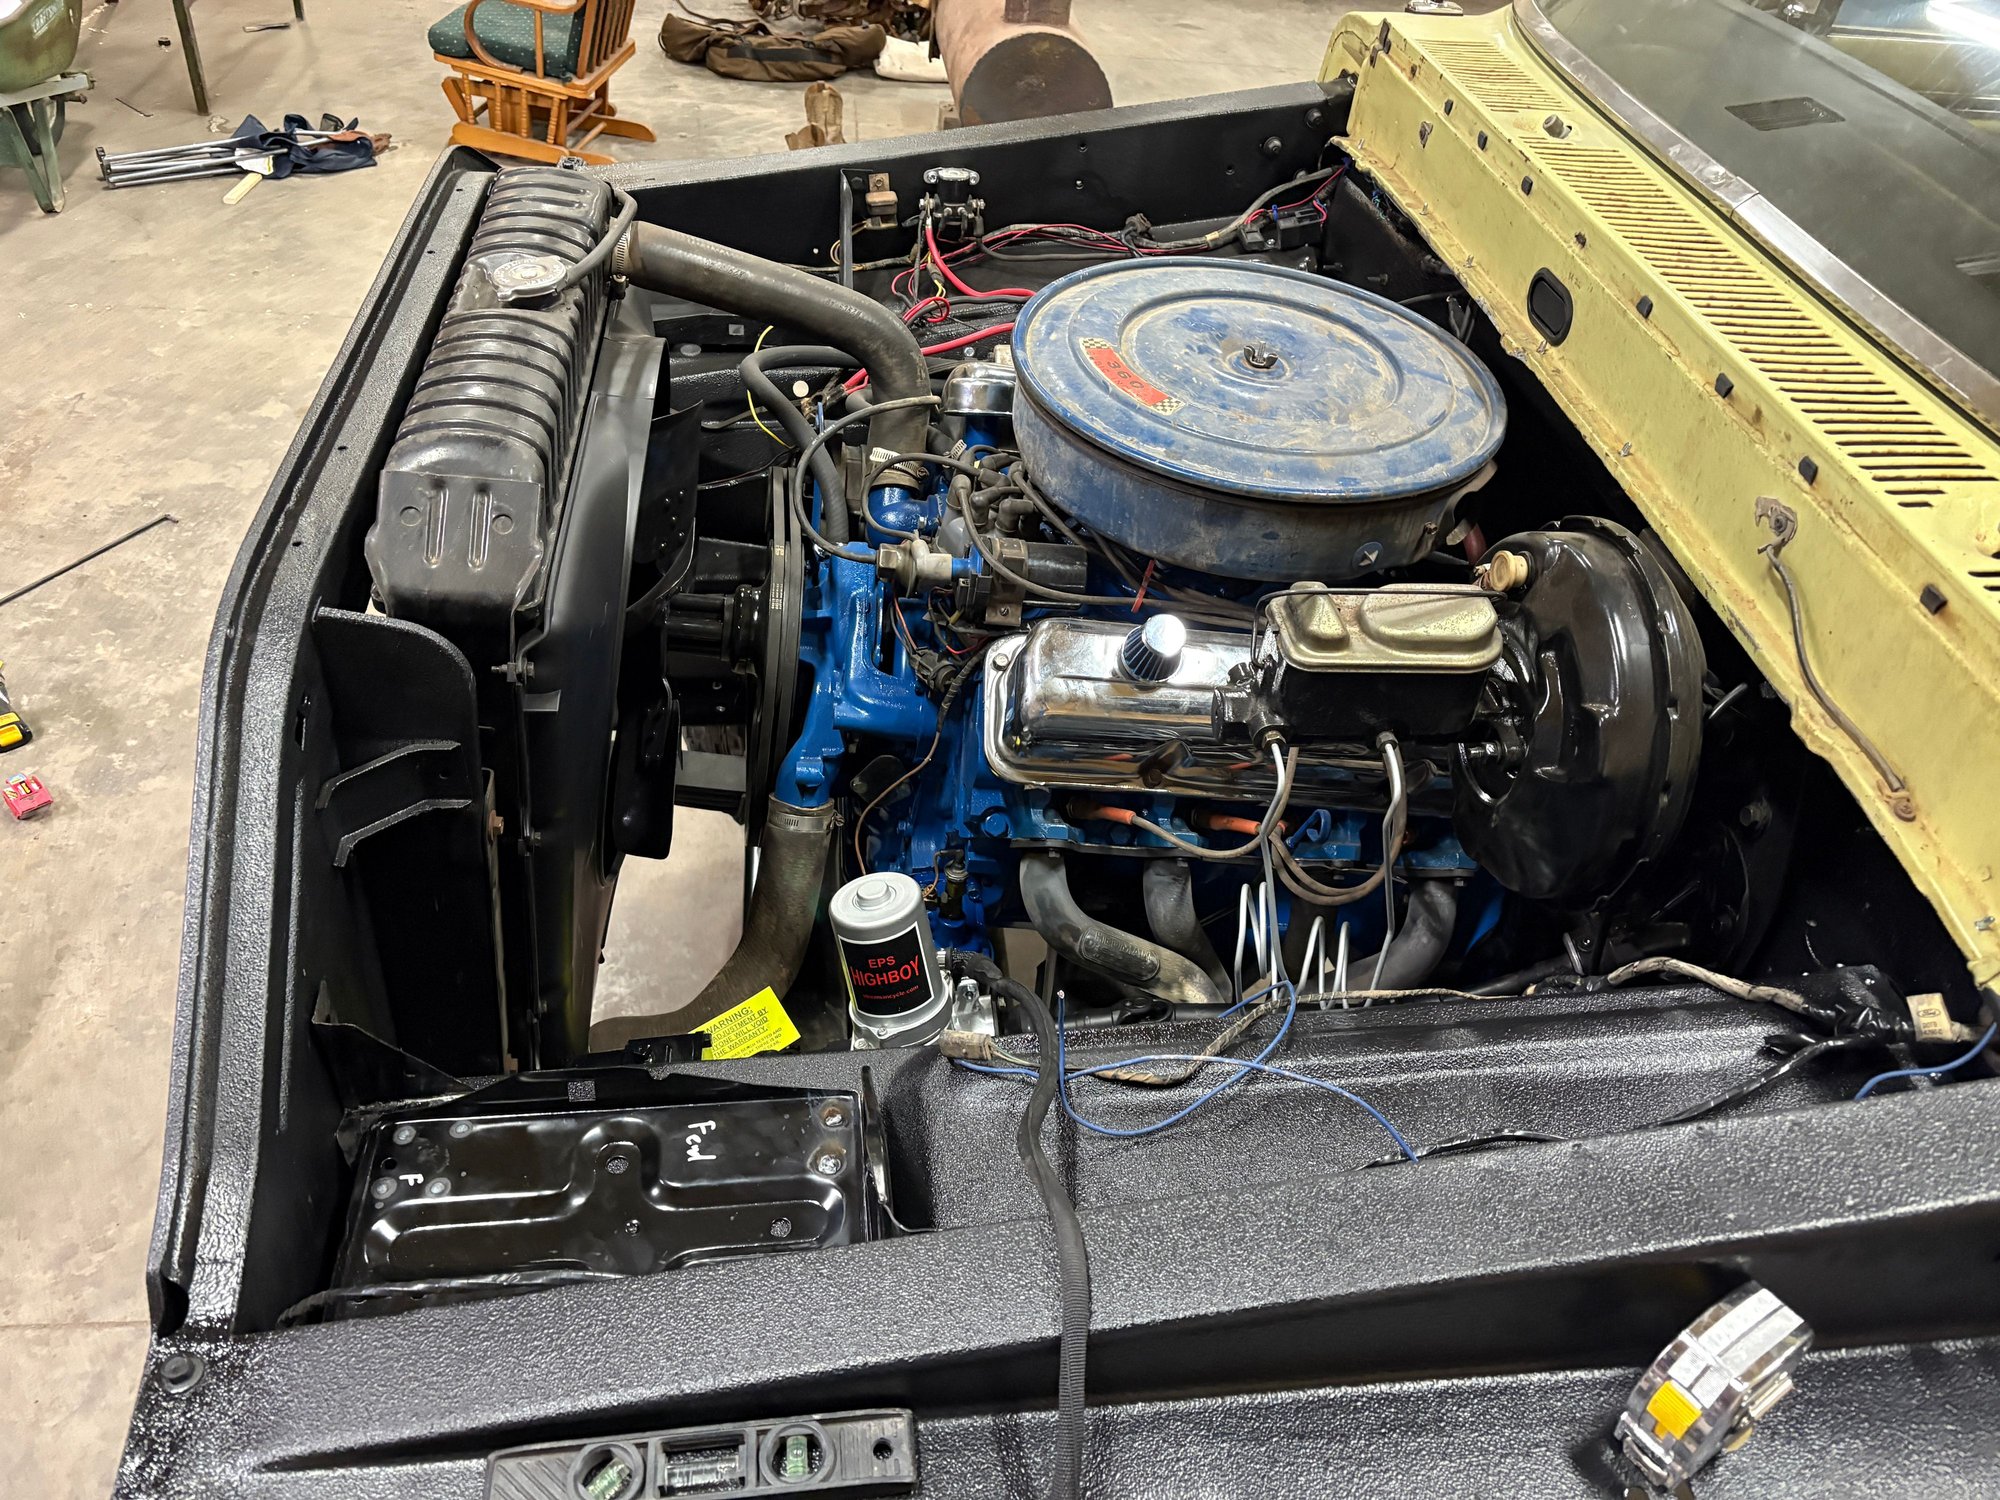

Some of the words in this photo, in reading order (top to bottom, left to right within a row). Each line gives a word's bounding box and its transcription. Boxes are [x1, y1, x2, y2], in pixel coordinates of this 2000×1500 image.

[1107, 361, 1145, 389] 360
[850, 955, 919, 986] HIGHBOY
[868, 956, 896, 968] EPS
[705, 1006, 754, 1034] WARNING:
[713, 1013, 757, 1042] ADJUSTMENT
[757, 1006, 769, 1018] BY
[733, 1026, 752, 1040] WILL
[751, 1016, 768, 1030] VOID
[713, 1049, 727, 1059] THE
[399, 1173, 425, 1187] F
